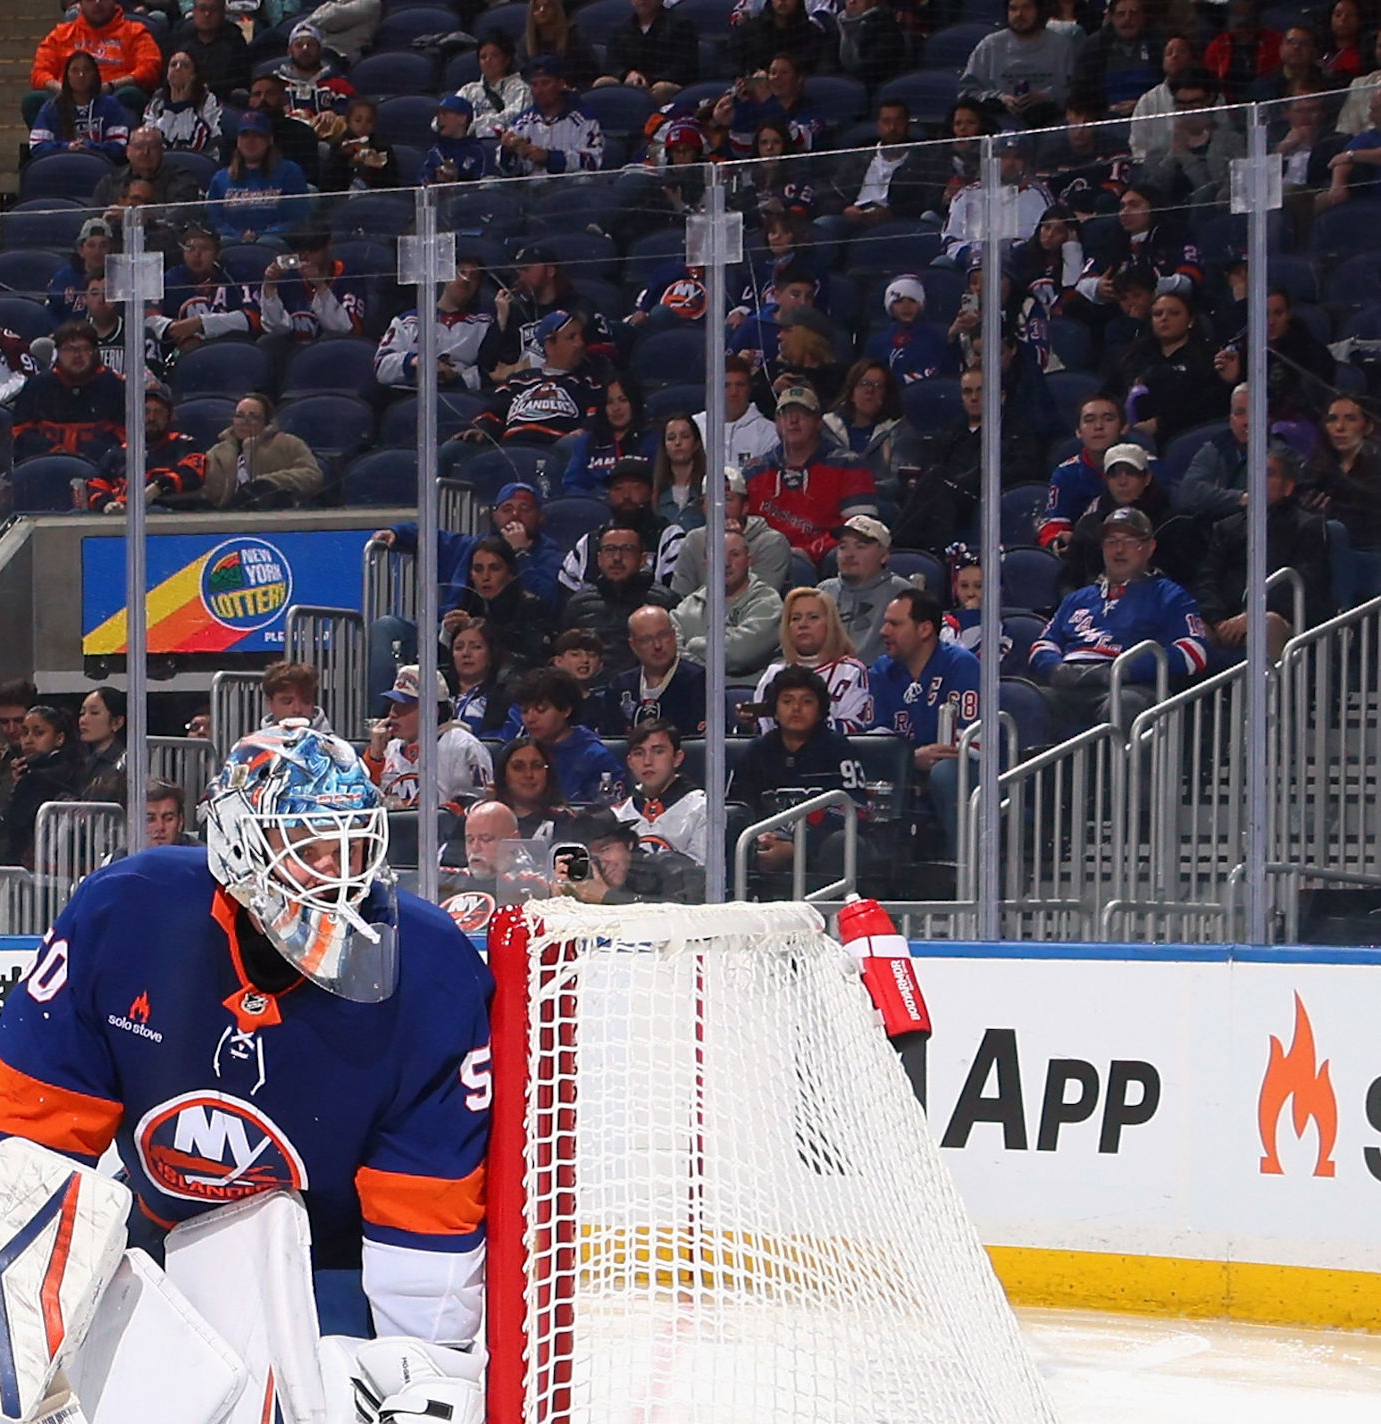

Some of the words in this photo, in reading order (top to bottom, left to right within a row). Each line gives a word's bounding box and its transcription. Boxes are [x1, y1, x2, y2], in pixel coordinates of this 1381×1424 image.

[241, 548, 273, 564] NEW
[245, 563, 282, 585] YORK
[209, 581, 286, 619] LOTTERY
[840, 759, 867, 789] 93
[29, 927, 68, 1002] 0
[891, 959, 921, 1022] BODYARMOR
[108, 1013, 131, 1029] solo
[132, 1022, 163, 1043] stove
[459, 1046, 492, 1113] 5
[156, 1158, 271, 1198] ISLANDE
